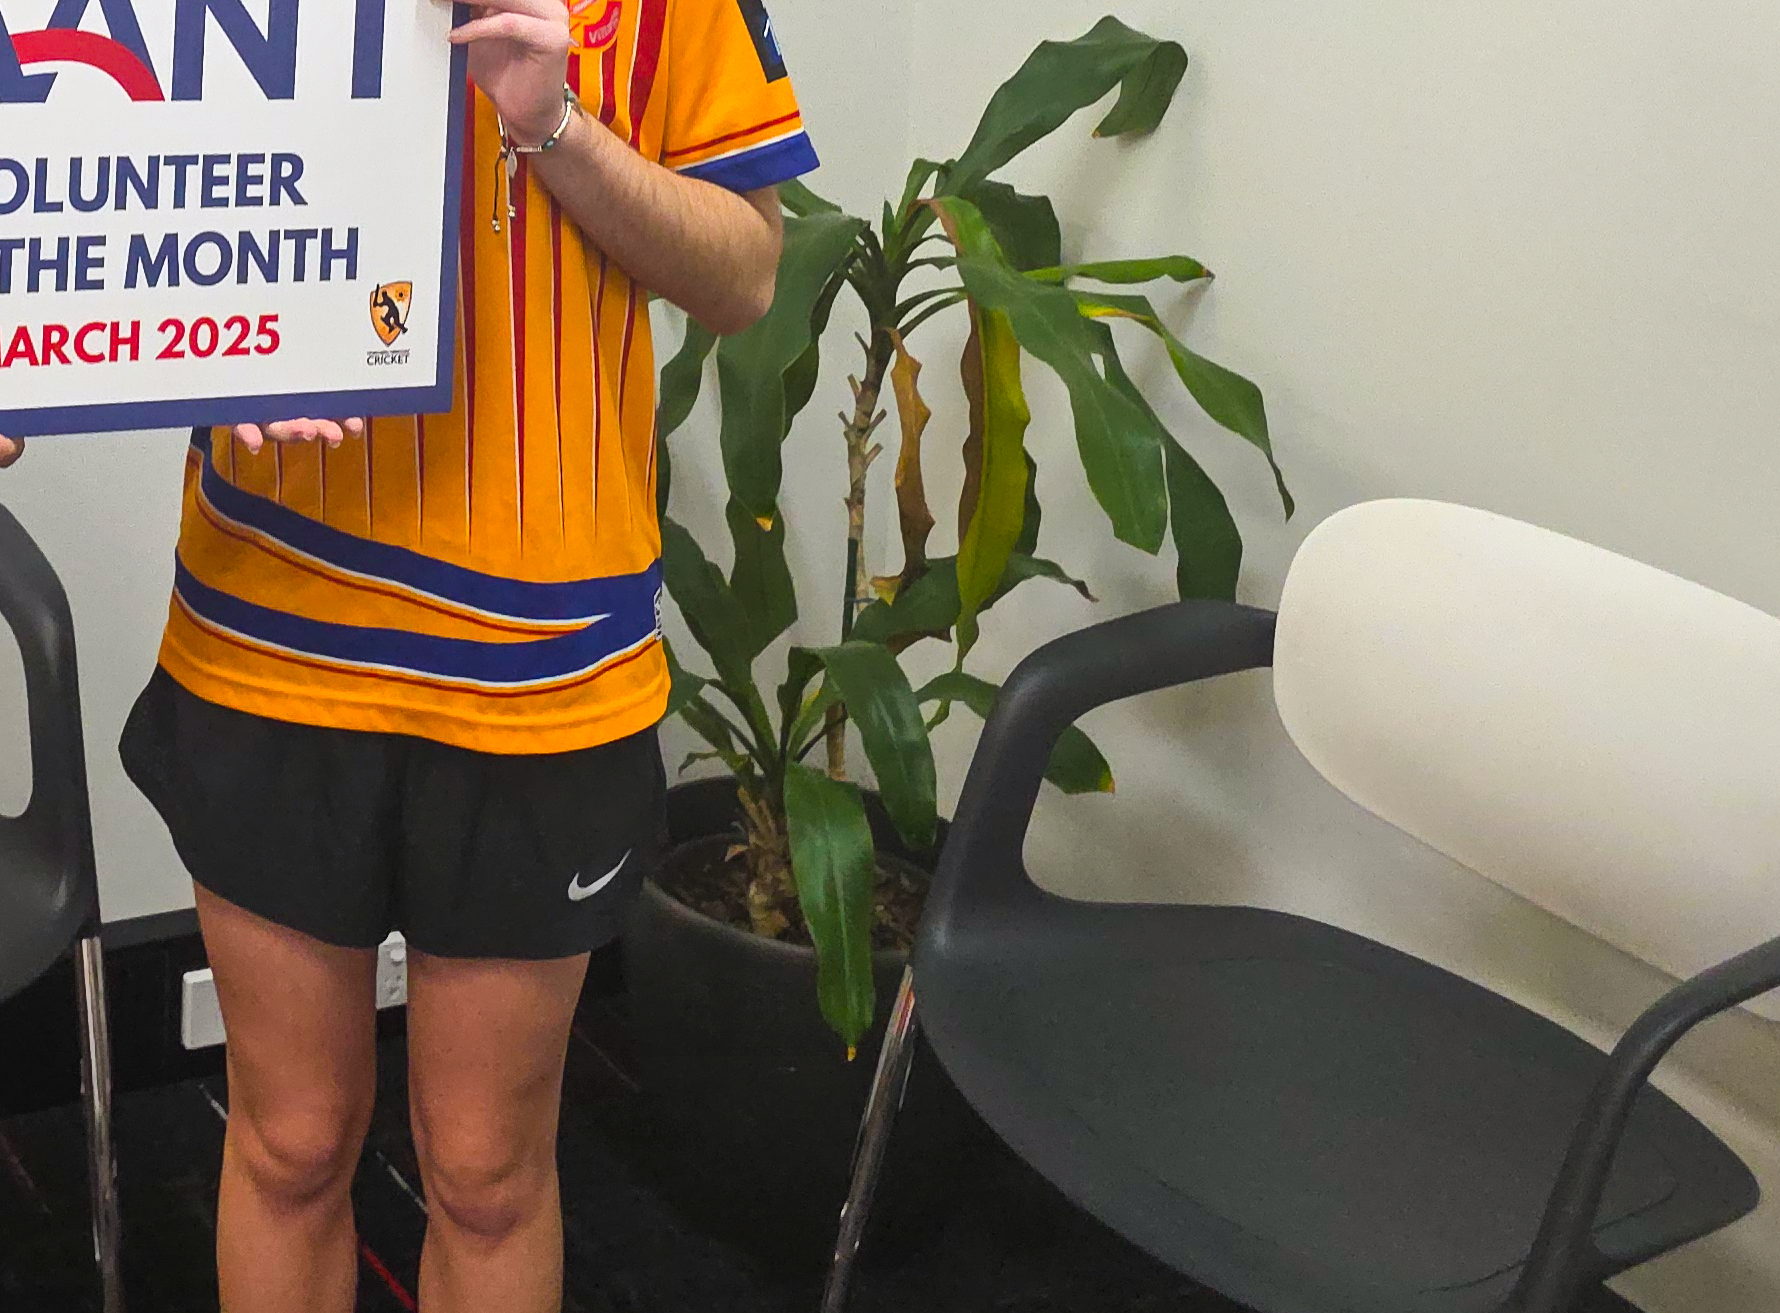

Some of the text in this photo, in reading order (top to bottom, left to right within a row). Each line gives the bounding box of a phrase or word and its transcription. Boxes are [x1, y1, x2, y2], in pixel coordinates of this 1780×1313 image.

[123, 226, 360, 289] MONTH
[156, 313, 281, 359] 2025
[366, 353, 409, 366] CRICKET
